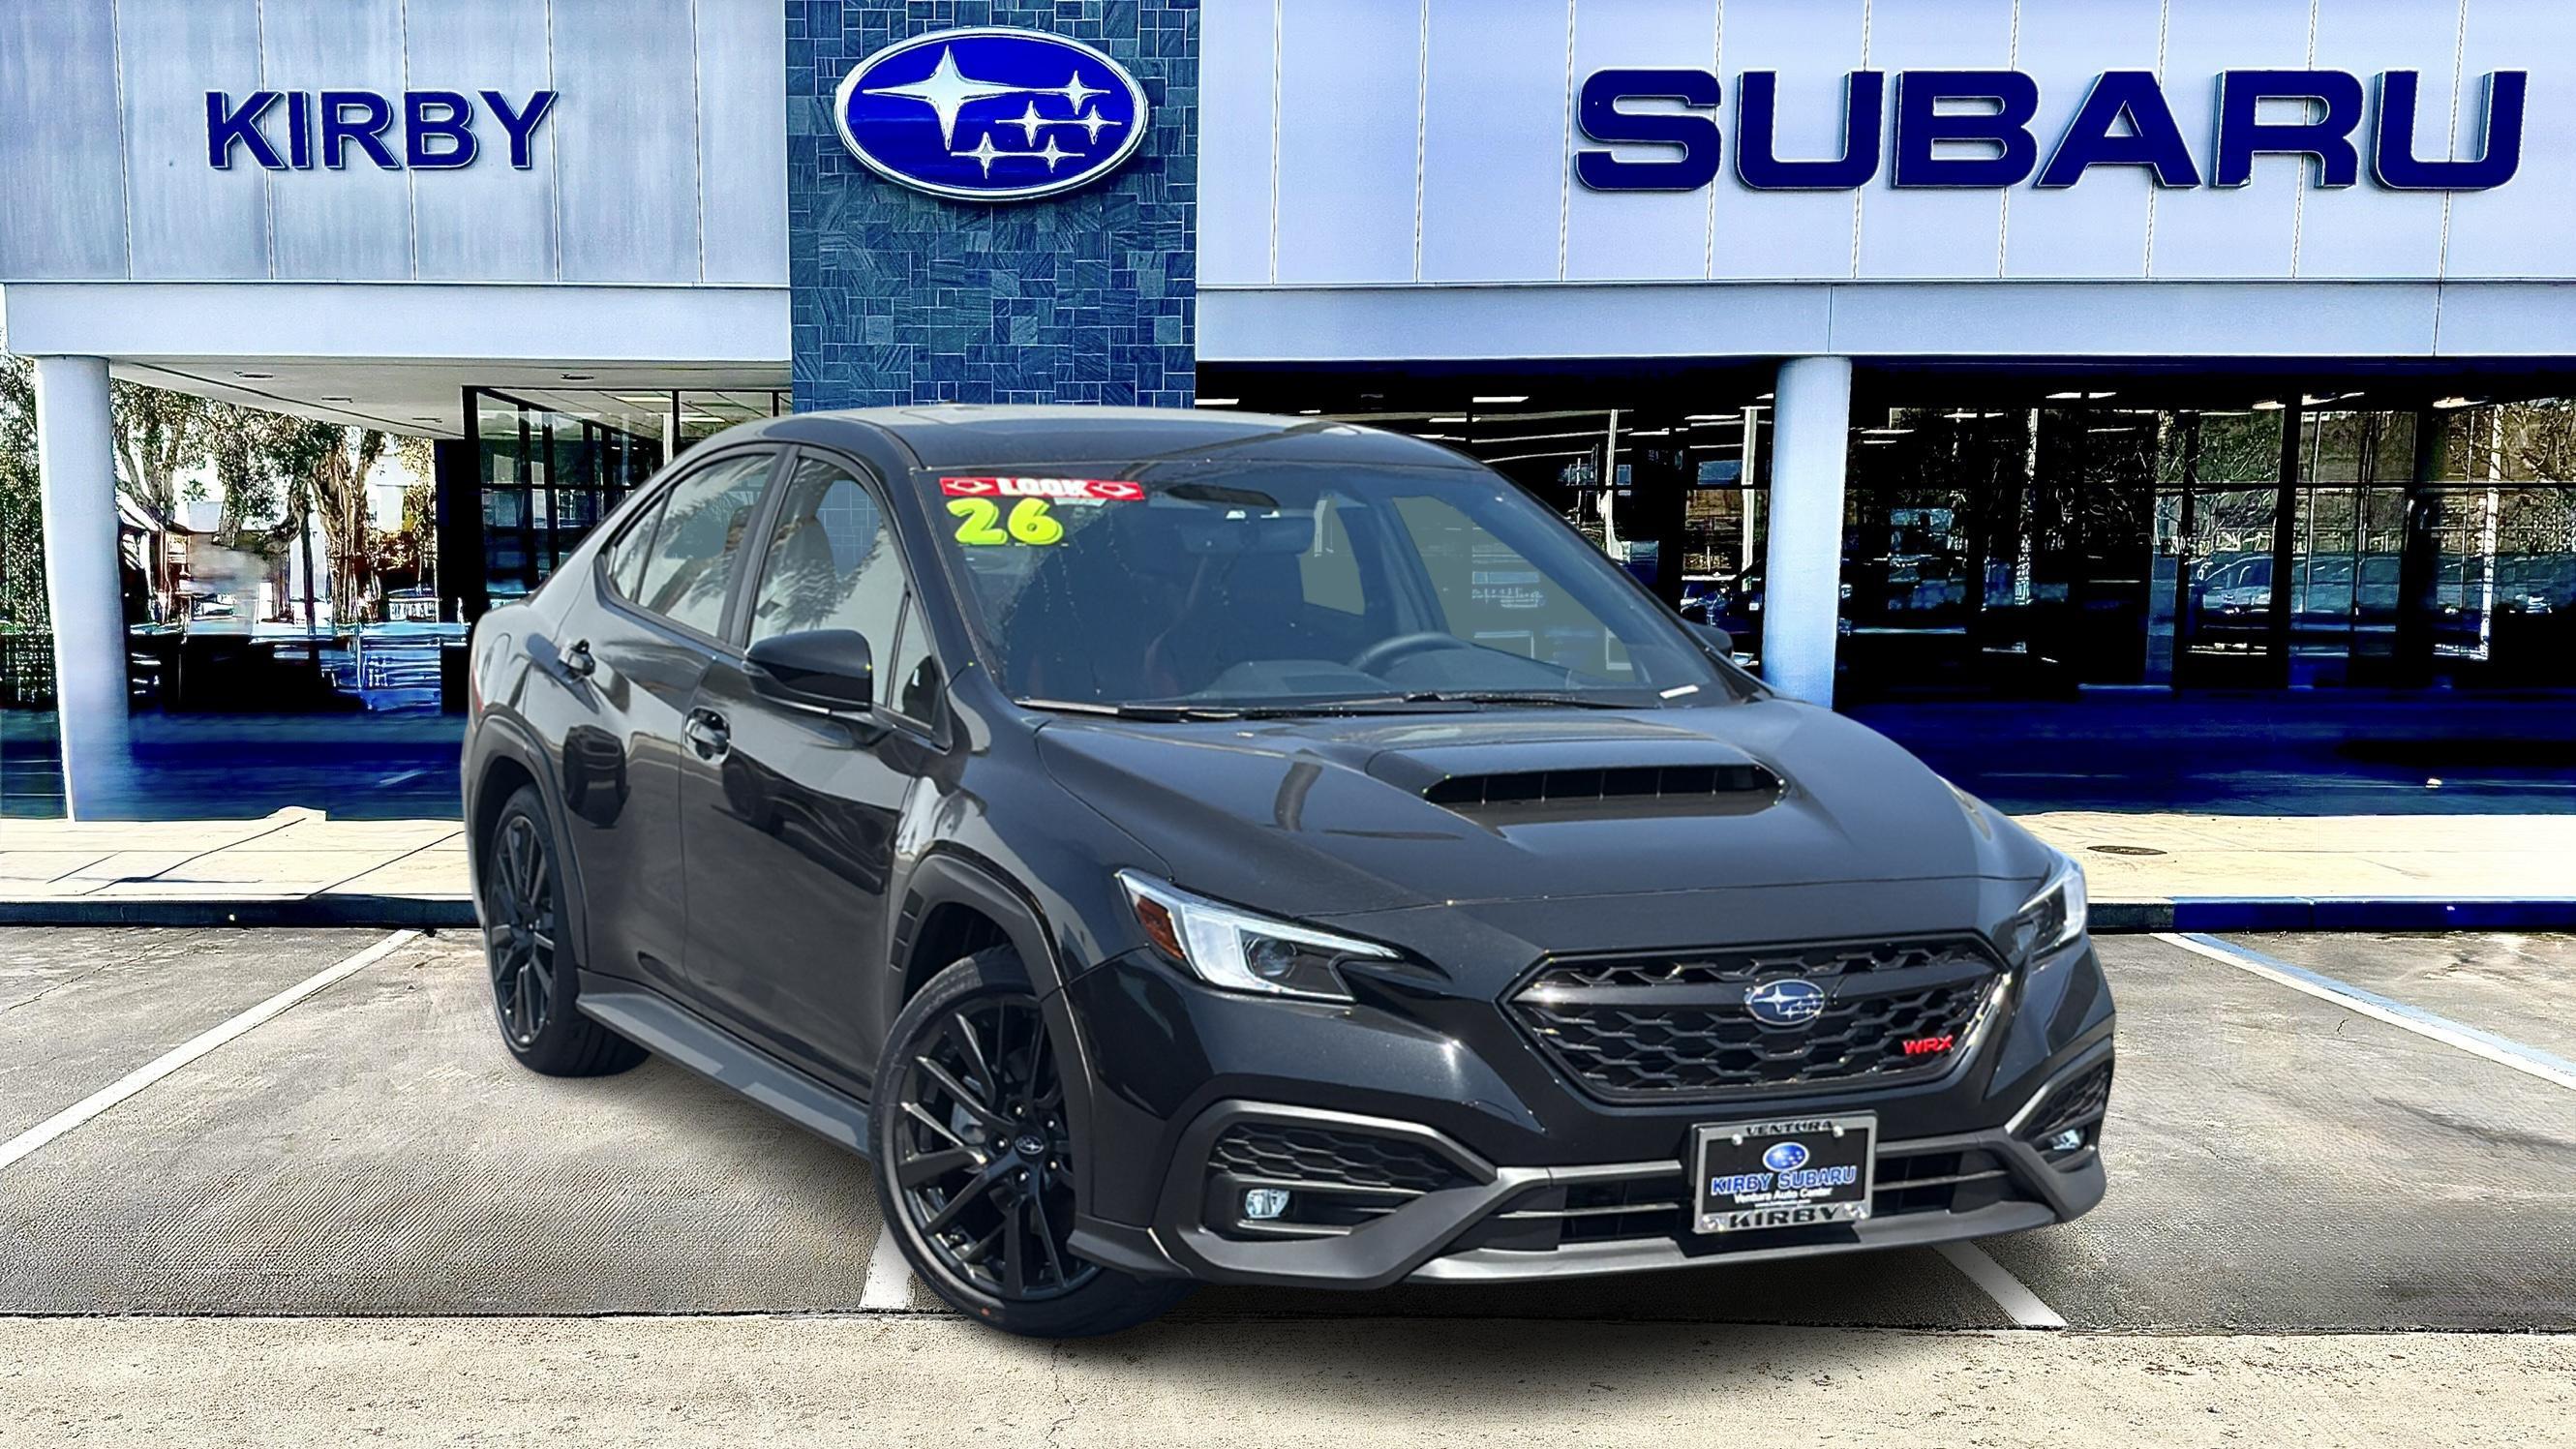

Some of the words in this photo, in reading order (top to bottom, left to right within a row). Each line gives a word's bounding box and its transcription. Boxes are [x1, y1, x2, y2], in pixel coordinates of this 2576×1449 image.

[204, 90, 560, 171] KIRBY
[1574, 68, 2528, 192] SUBARU
[996, 478, 1094, 497] LOOK
[947, 498, 1063, 544] 26
[1902, 1035, 1954, 1055] WRX
[1746, 1120, 1834, 1135] VENTURA
[1712, 1173, 1773, 1195] KIRBY
[1777, 1165, 1857, 1189] SUBARU
[1734, 1192, 1772, 1203] Ventura
[1774, 1190, 1797, 1199] Auto
[1801, 1188, 1832, 1197] Center
[1730, 1206, 1838, 1228] KIRBY
